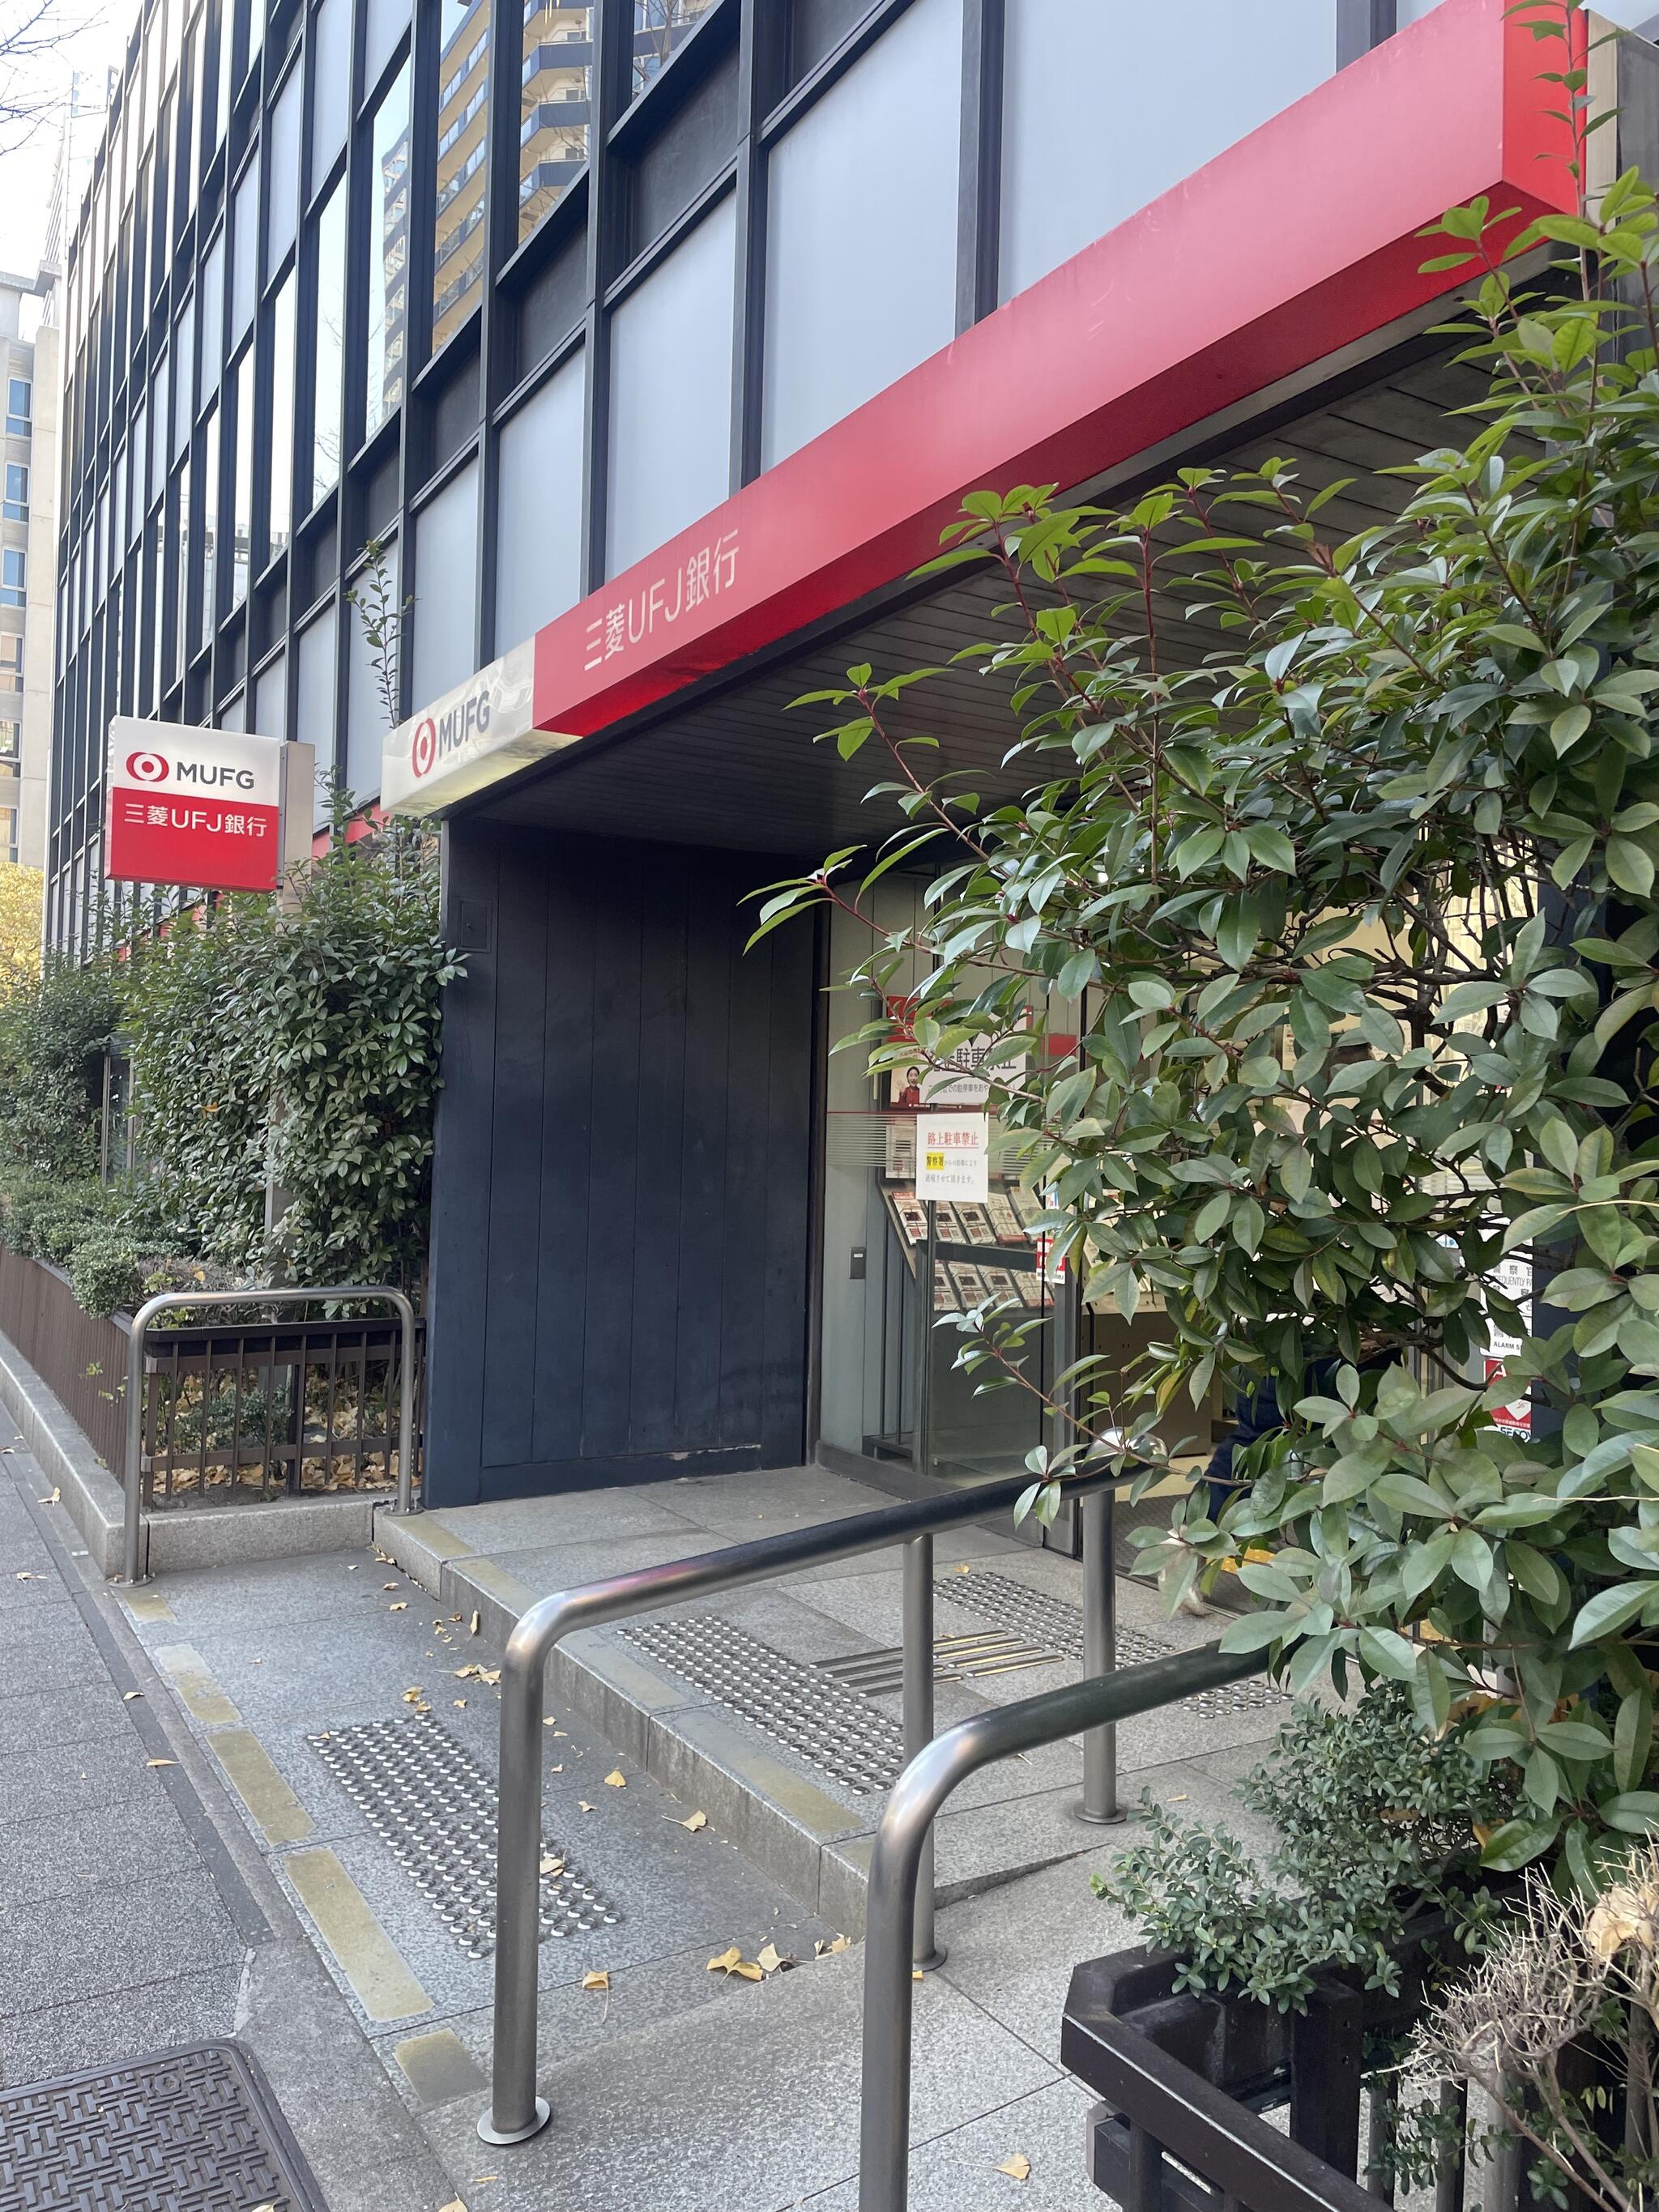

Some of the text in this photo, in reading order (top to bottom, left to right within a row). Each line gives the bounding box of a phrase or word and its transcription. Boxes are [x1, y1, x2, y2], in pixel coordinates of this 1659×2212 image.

[584, 528, 740, 671] 三菱UFJ銀行
[438, 690, 491, 757] MUFG
[177, 761, 254, 790] MUFG
[124, 803, 267, 837] 三菱UFJ銀行
[928, 1132, 979, 1145] 路上駐車禁止
[1494, 1341, 1514, 1349] ALARM
